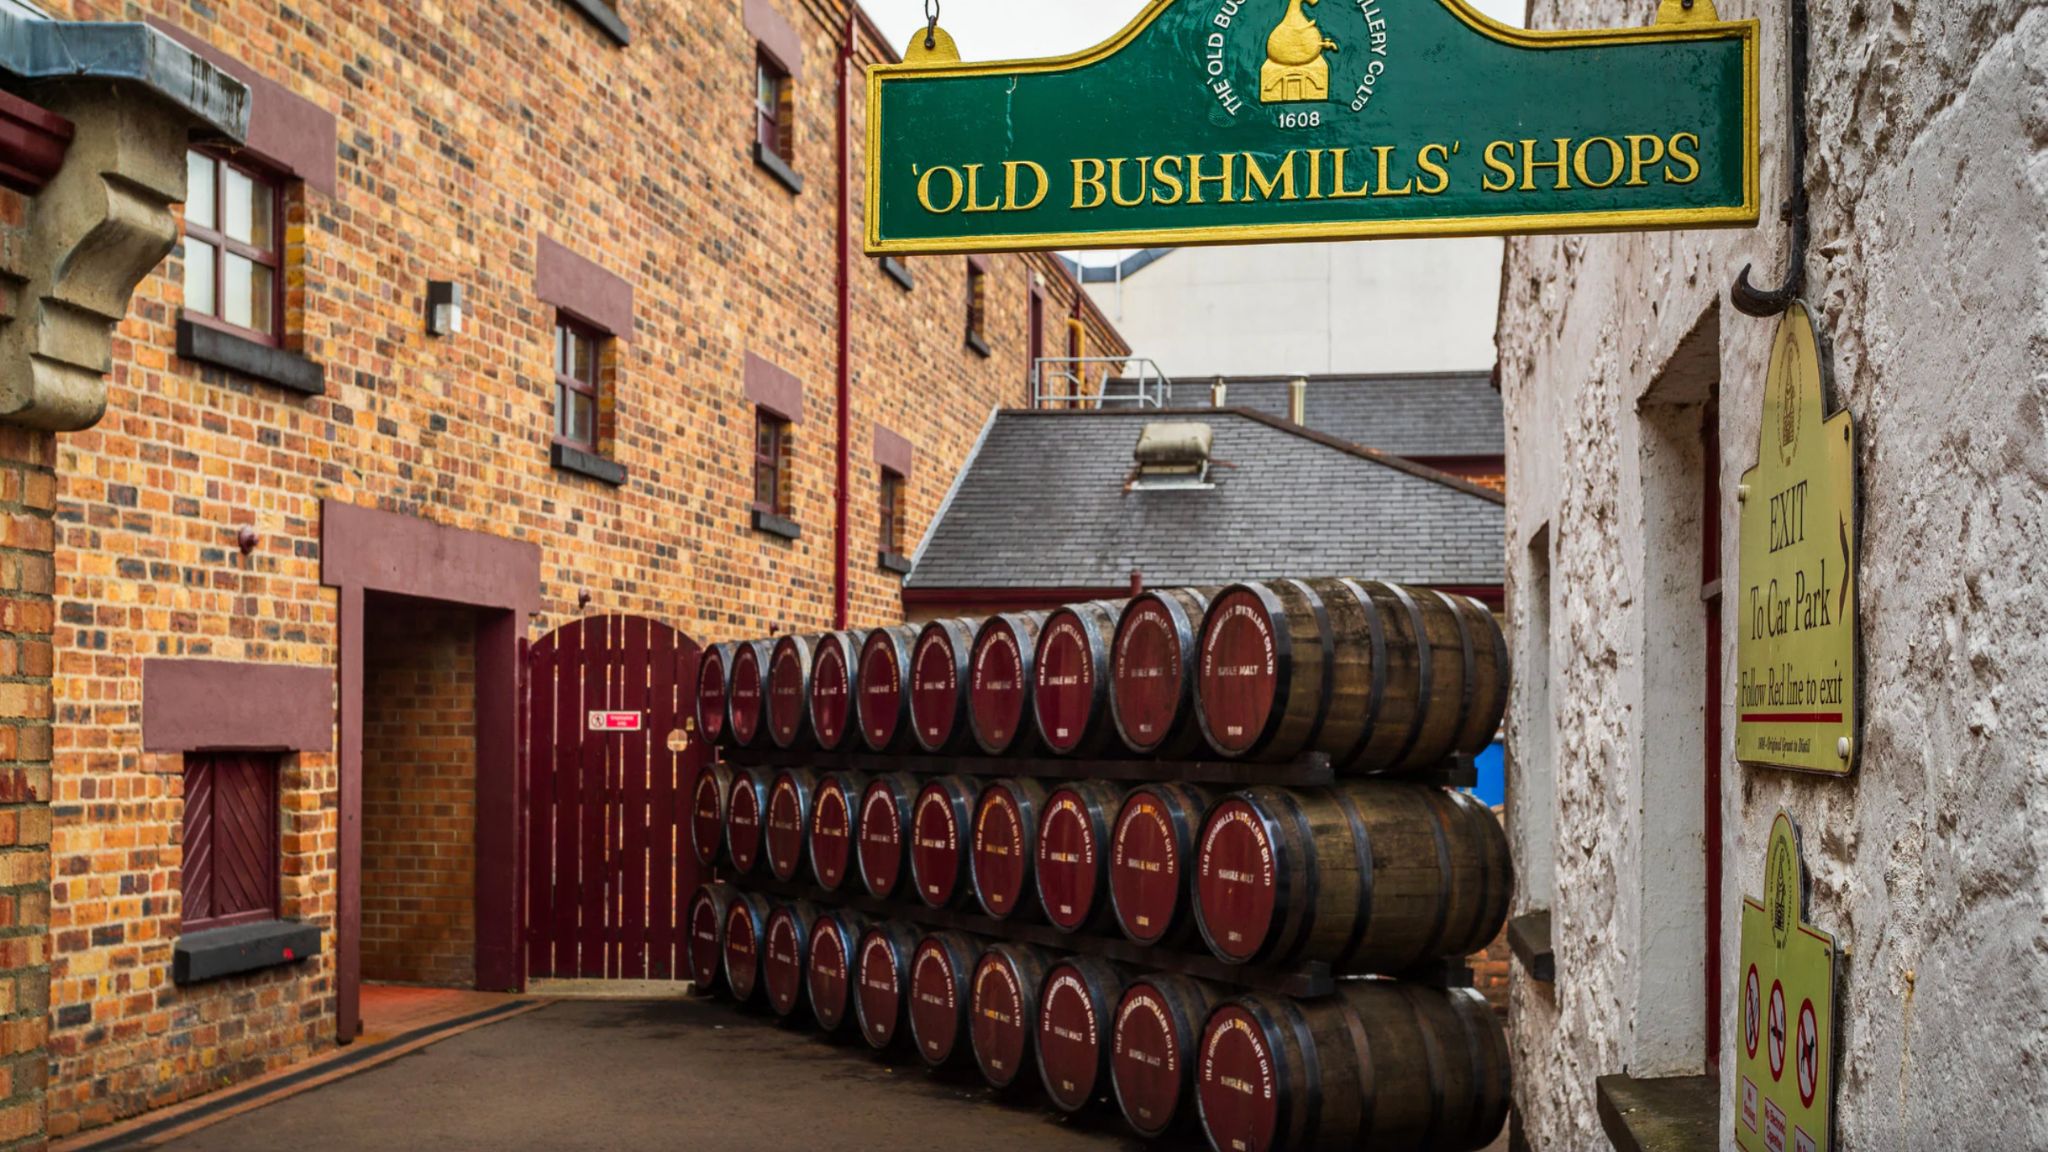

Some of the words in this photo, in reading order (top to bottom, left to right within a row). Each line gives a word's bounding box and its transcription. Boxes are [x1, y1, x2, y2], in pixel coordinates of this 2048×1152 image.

[1213, 79, 1242, 116] THE
[1279, 111, 1320, 128] 1608
[1070, 140, 1460, 209] BUSHMILLS'
[1482, 132, 1701, 192] SHOPS
[1768, 480, 1808, 554] EXIT
[1751, 585, 1764, 640] To
[1767, 578, 1791, 638] Car
[1794, 558, 1831, 632] Park
[1741, 667, 1766, 707] Follow
[1768, 662, 1784, 706] Red
[1786, 662, 1804, 705] line
[1806, 672, 1817, 705] to
[1820, 659, 1843, 705] exit
